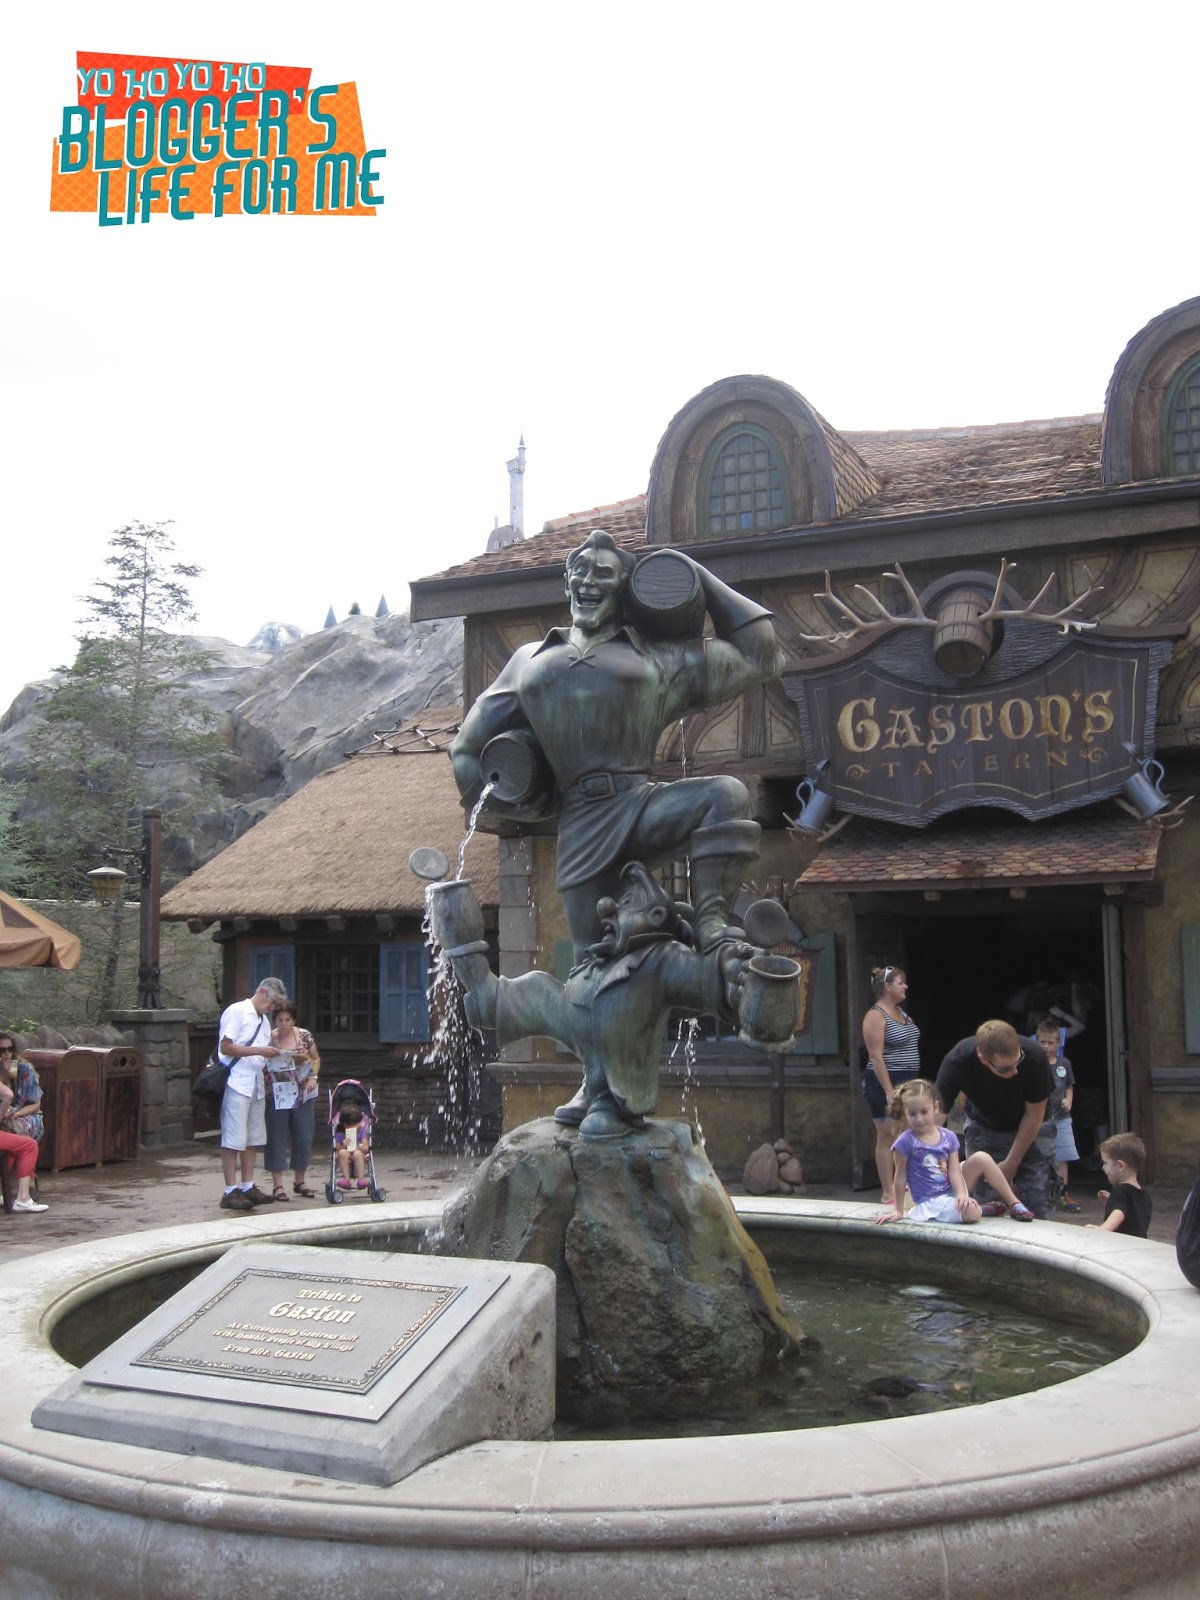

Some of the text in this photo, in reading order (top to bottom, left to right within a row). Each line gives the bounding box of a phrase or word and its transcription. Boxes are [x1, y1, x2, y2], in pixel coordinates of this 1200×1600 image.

[880, 749, 1068, 778] TAVERN
[296, 1288, 363, 1304] Tribute to
[269, 1301, 357, 1325] Gaston
[212, 1329, 223, 1337] to
[221, 1330, 236, 1339] the
[265, 1335, 297, 1346] People
[322, 1341, 355, 1353] Village
[299, 1329, 339, 1341] Generous
[338, 1333, 360, 1343] Gift
[221, 1343, 252, 1354] From
[273, 1348, 316, 1362] Gaston
